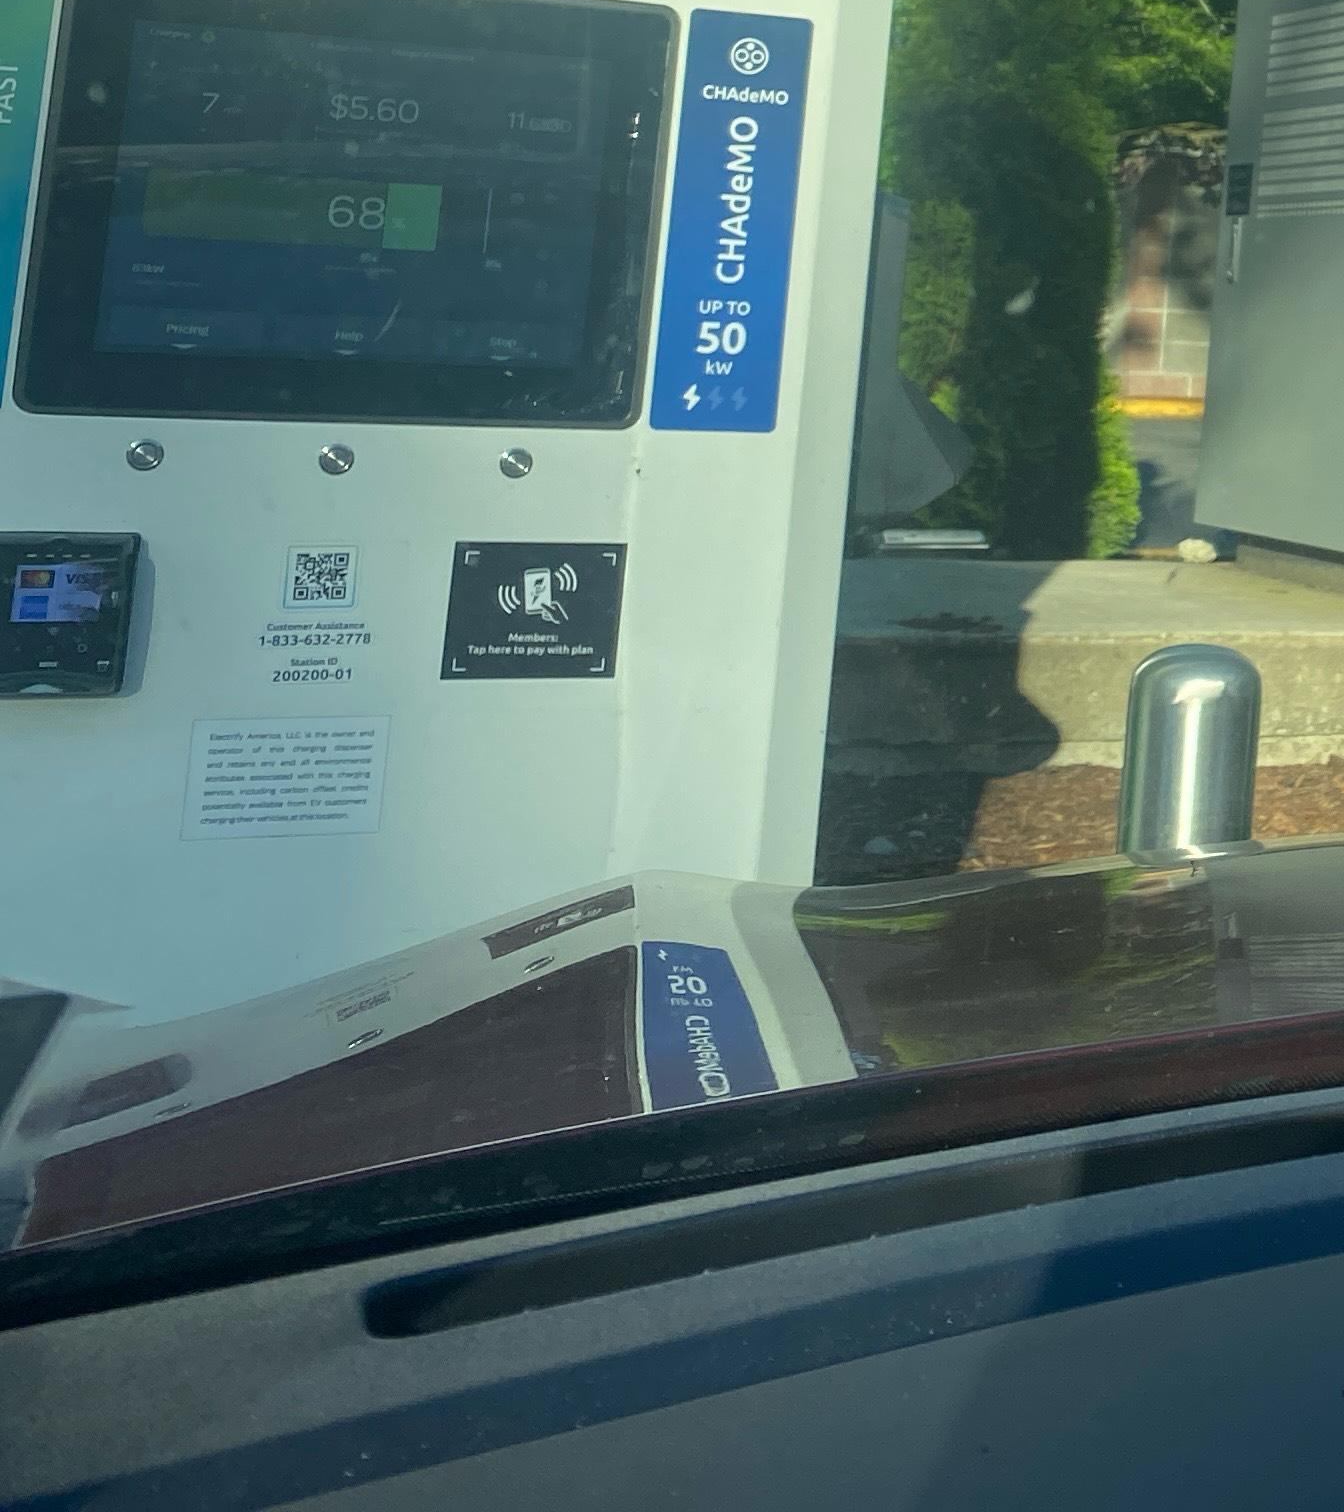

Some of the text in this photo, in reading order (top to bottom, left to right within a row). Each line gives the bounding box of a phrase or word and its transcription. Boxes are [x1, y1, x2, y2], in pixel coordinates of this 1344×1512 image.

[702, 84, 789, 106] CHAdeMO
[329, 92, 420, 124] $5.60
[714, 115, 759, 285] CHAdeMO
[328, 195, 386, 230] 68
[699, 299, 751, 316] UP TO
[696, 321, 747, 355] 50
[705, 360, 733, 376] kW
[259, 633, 371, 647] 1-833-632-2778
[468, 645, 594, 657] Tap here to pay with plan
[273, 668, 352, 682] 200200-01
